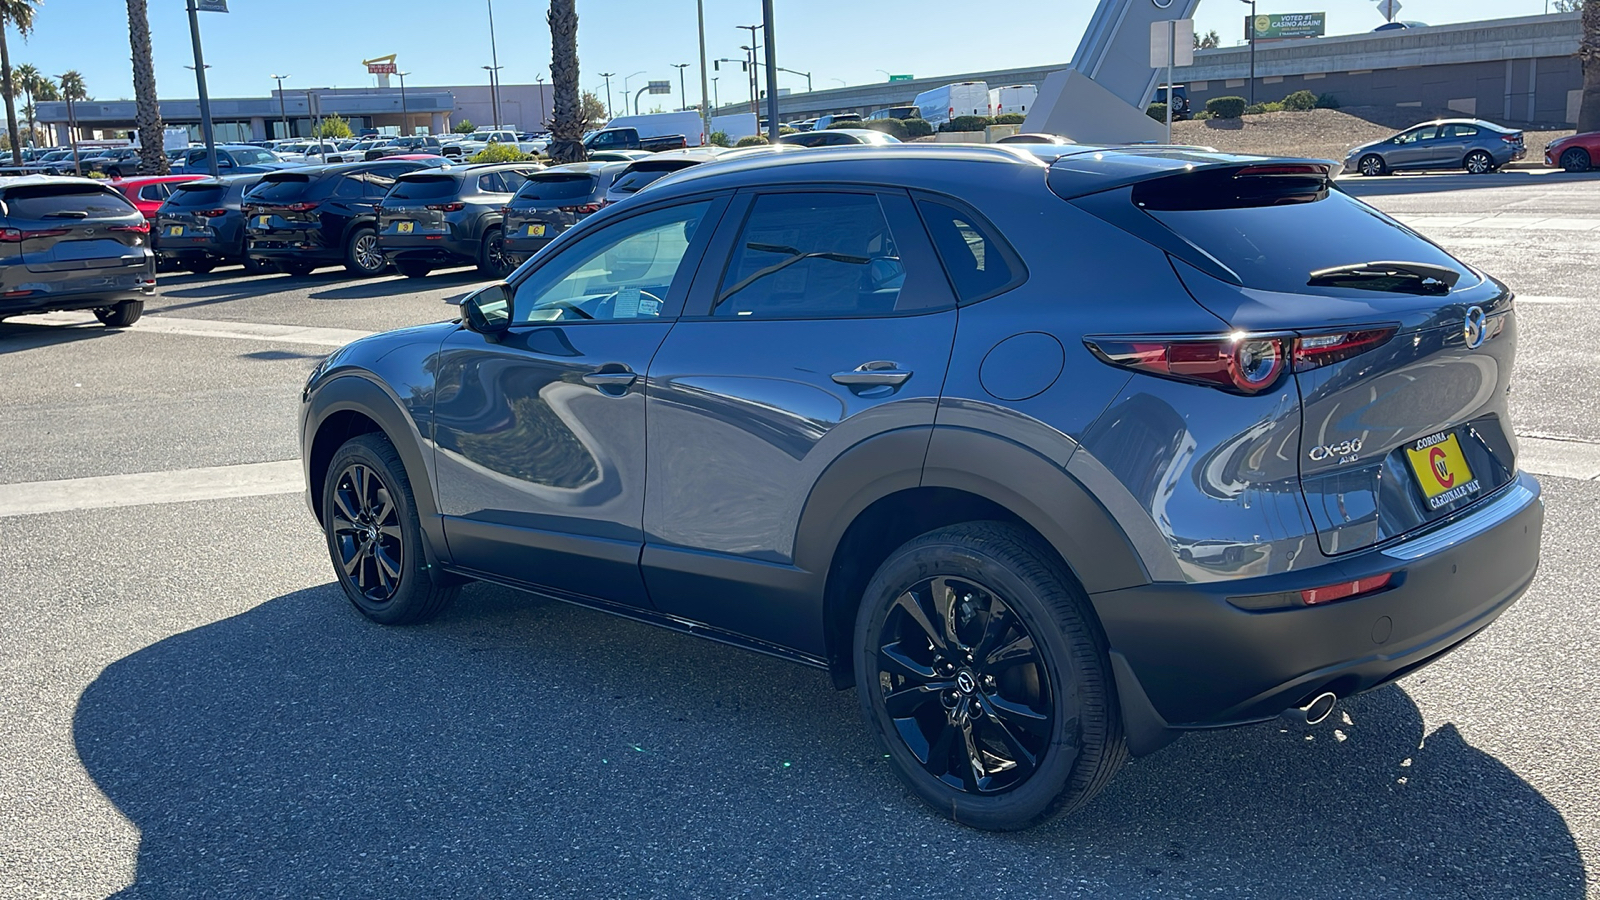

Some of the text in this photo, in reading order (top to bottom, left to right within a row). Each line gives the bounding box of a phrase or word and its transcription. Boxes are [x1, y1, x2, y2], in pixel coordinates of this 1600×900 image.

[1309, 437, 1362, 461] CX-30
[1417, 432, 1446, 449] CORONA
[1338, 453, 1359, 465] AWD
[1430, 479, 1481, 509] CARDINALE WAY
